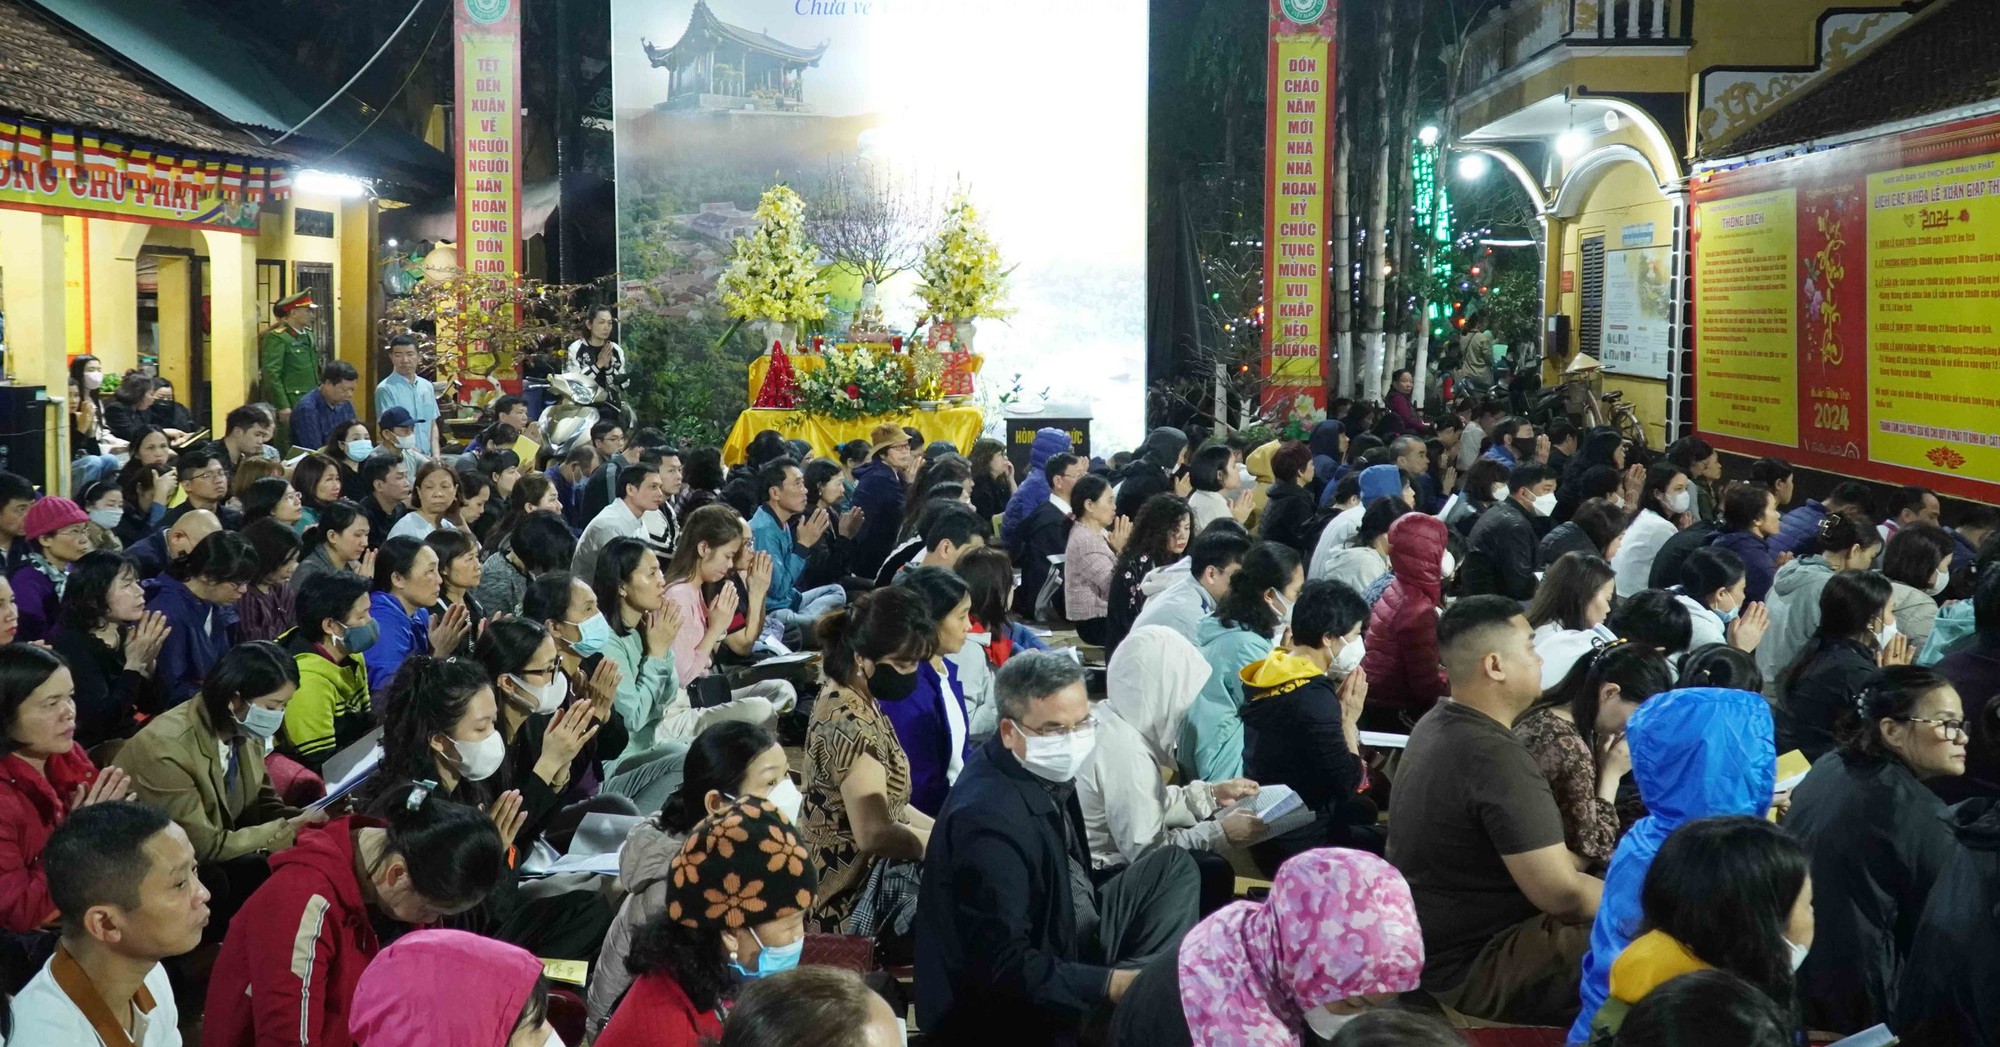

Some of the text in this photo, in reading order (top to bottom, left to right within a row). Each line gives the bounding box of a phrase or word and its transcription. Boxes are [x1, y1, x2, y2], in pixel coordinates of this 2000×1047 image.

[477, 56, 500, 72] TẾT
[1289, 56, 1316, 72] ĐÓN
[476, 77, 501, 92] ĐẾN
[1284, 77, 1320, 93] CHÀO
[471, 97, 505, 112] XUÂN
[1287, 98, 1316, 113] NĂM
[480, 117, 496, 132] VỀ
[1288, 118, 1314, 134] MỚI
[468, 137, 509, 153] NGƯỜI
[1287, 139, 1313, 154] NHÀ
[468, 158, 509, 173] NGƯỜI
[1286, 160, 1312, 175] NHÀ
[476, 178, 502, 192] HÂN
[1281, 182, 1316, 195] HOAN
[472, 200, 507, 213] HOAN
[1290, 199, 1307, 215] HỶ
[472, 220, 507, 233] CUNG
[1280, 220, 1316, 236] CHÚC
[476, 237, 503, 253] ĐÓN
[1281, 244, 1315, 259] TỤNG
[474, 260, 505, 273] GIAO
[1278, 261, 1317, 277] MỪNG
[1286, 284, 1308, 296] VUI
[1280, 301, 1314, 317] KHẮP
[1284, 320, 1308, 336] NẺO
[1274, 342, 1317, 357] ĐƯỜNG
[1814, 402, 1850, 431] 2024
